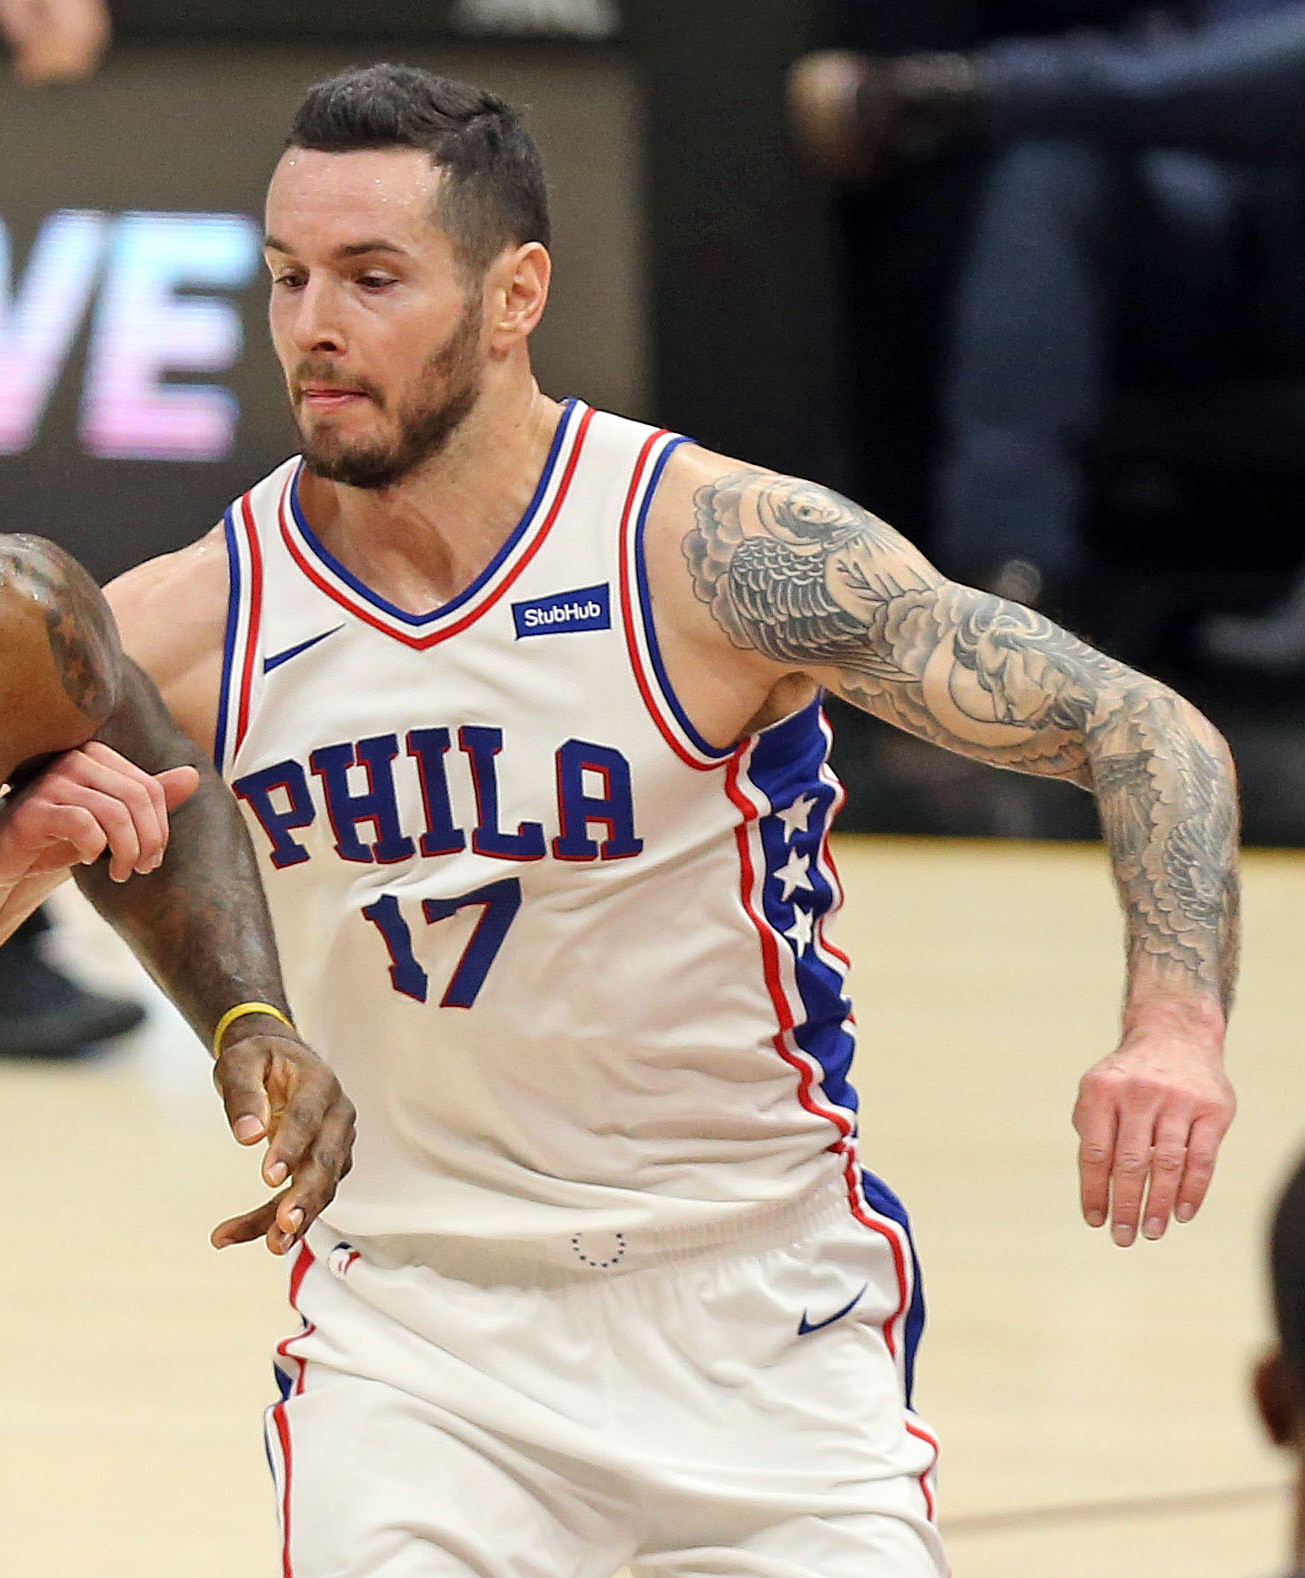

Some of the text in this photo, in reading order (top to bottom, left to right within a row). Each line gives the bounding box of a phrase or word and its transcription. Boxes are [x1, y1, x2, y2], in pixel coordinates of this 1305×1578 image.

[524, 601, 601, 627] StubHub
[232, 726, 643, 869] PHILA
[362, 877, 523, 1008] 17
